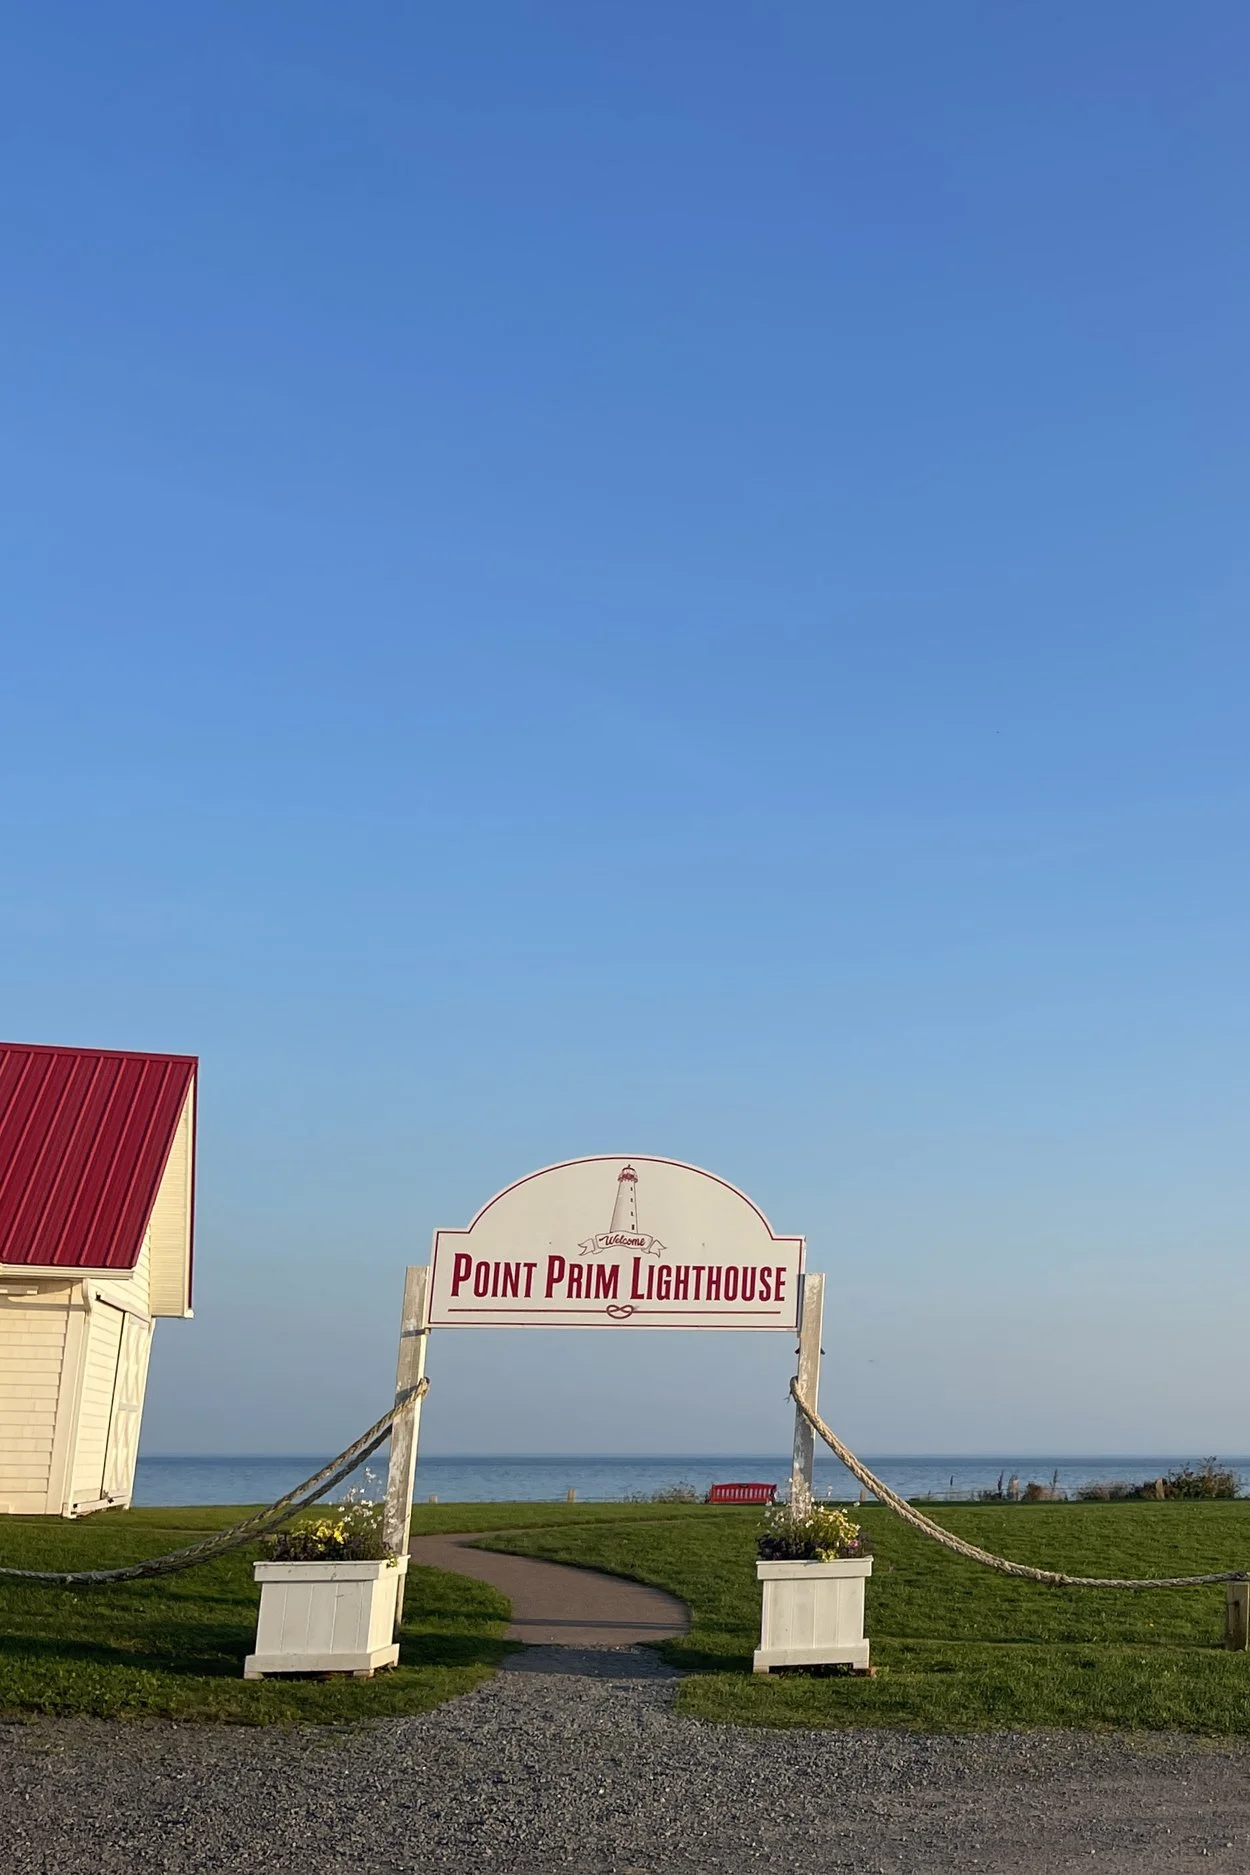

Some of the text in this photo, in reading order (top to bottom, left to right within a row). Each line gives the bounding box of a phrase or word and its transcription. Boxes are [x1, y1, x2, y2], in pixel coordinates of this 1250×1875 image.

[598, 1234, 645, 1246] Welcome
[450, 1252, 787, 1302] POINT PRIM LIGHTHOUSE
